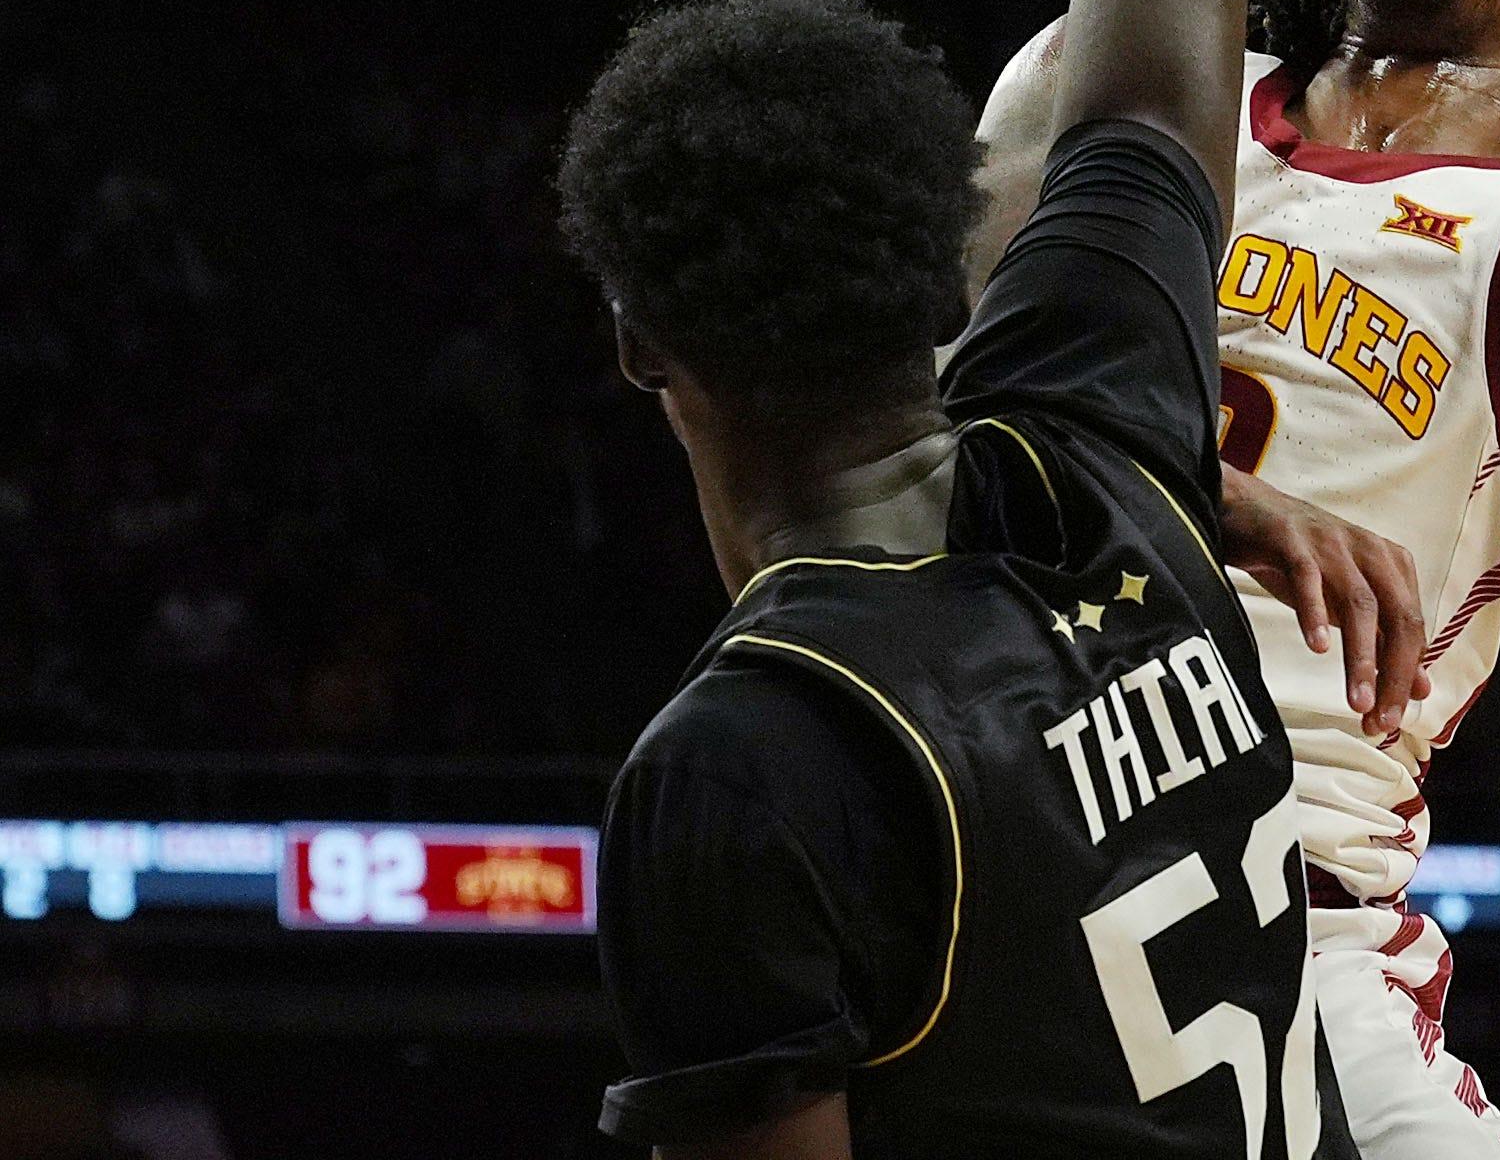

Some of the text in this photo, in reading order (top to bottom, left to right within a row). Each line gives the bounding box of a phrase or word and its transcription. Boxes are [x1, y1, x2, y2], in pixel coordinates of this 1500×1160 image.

[1378, 193, 1474, 254] XII
[1217, 233, 1452, 440] ONES
[1043, 629, 1267, 845] THIA
[307, 829, 428, 925] 92
